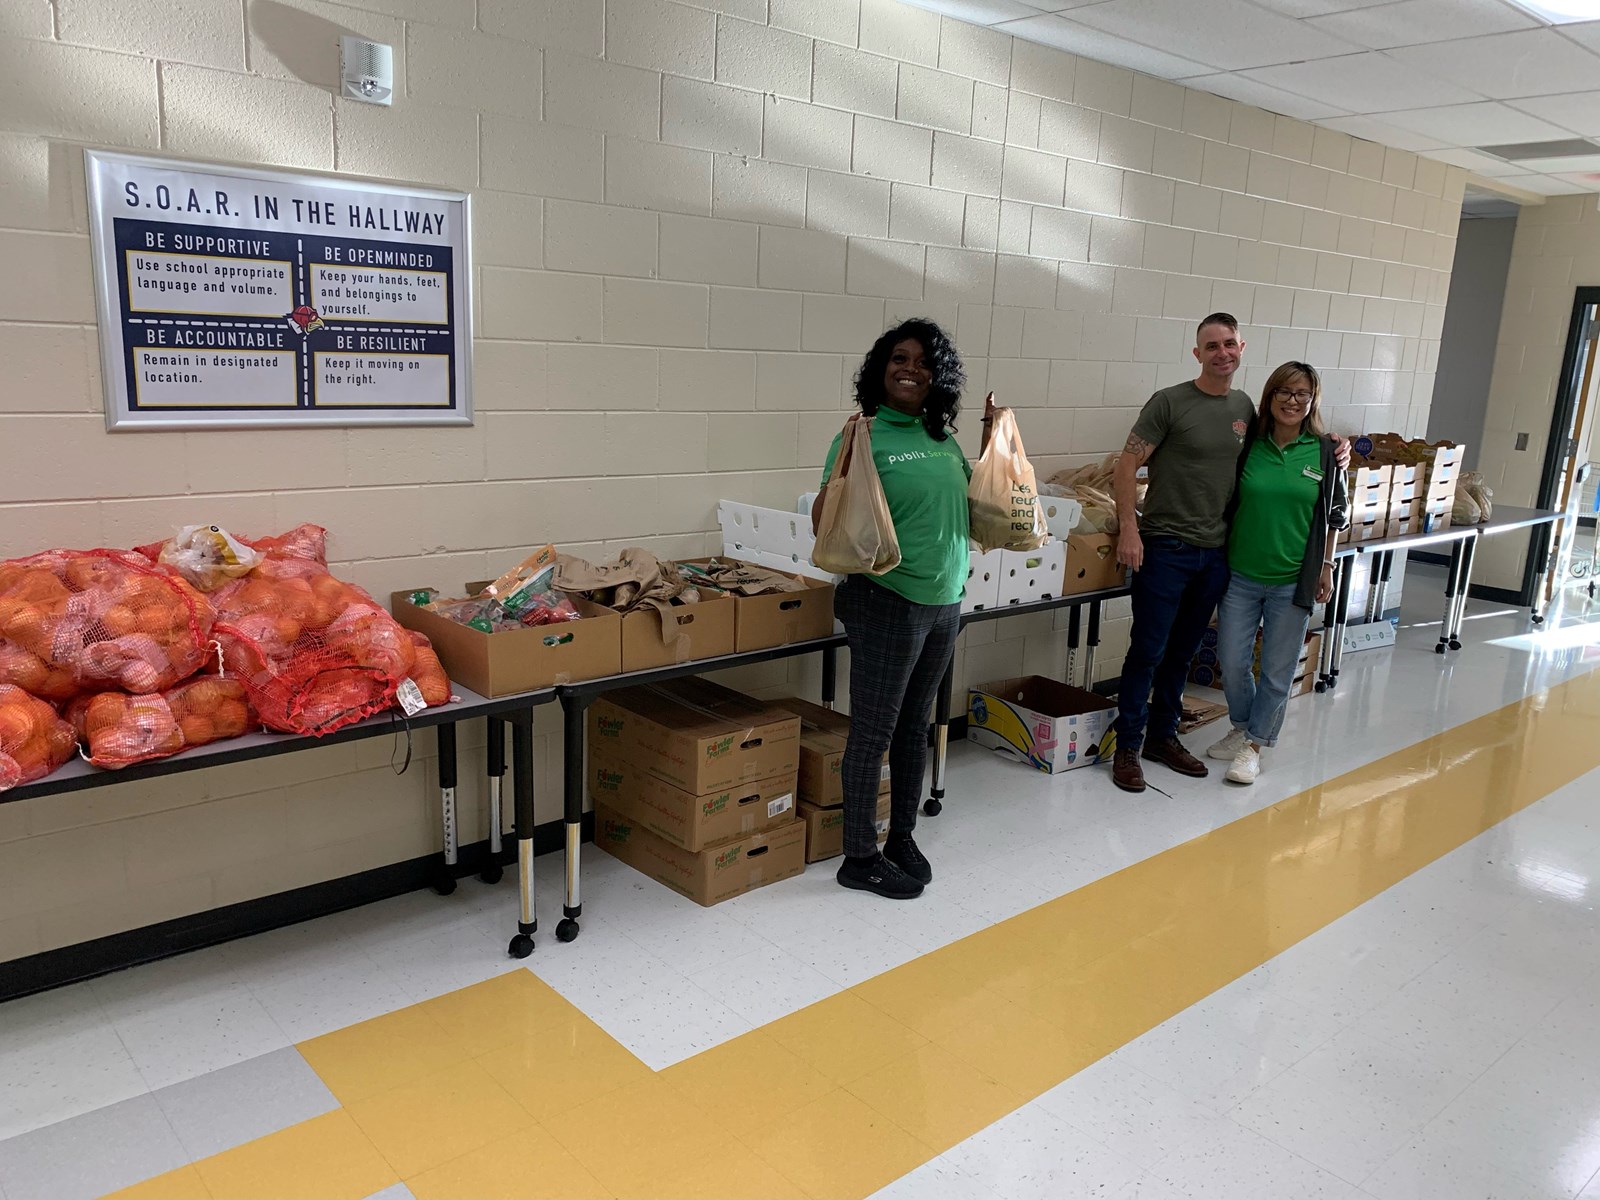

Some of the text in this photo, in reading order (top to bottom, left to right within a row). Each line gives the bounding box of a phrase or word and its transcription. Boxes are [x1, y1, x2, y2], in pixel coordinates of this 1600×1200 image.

[124, 181, 444, 236] S.O.A.R. IN THE HALLWAY
[145, 232, 270, 256] BE SUPPORTIVE
[325, 246, 433, 268] BE OPENMINDED
[136, 258, 285, 280] Use school appropriate
[137, 277, 277, 296] language and volume.
[320, 270, 346, 284] Keep
[352, 273, 374, 285] your
[417, 276, 440, 288] feet,
[321, 287, 417, 303] and belongings to
[322, 304, 370, 316] yourself.
[146, 329, 284, 348] BE ACCOUNTABLE
[337, 336, 426, 351] BE RESILIENT
[144, 354, 278, 369] Remain in designated
[325, 358, 351, 370] Keep
[355, 359, 363, 369] it
[368, 359, 404, 371] moving
[145, 371, 202, 383] location.
[325, 374, 376, 386] the right.
[888, 450, 926, 464] Publix
[1011, 507, 1034, 518] and
